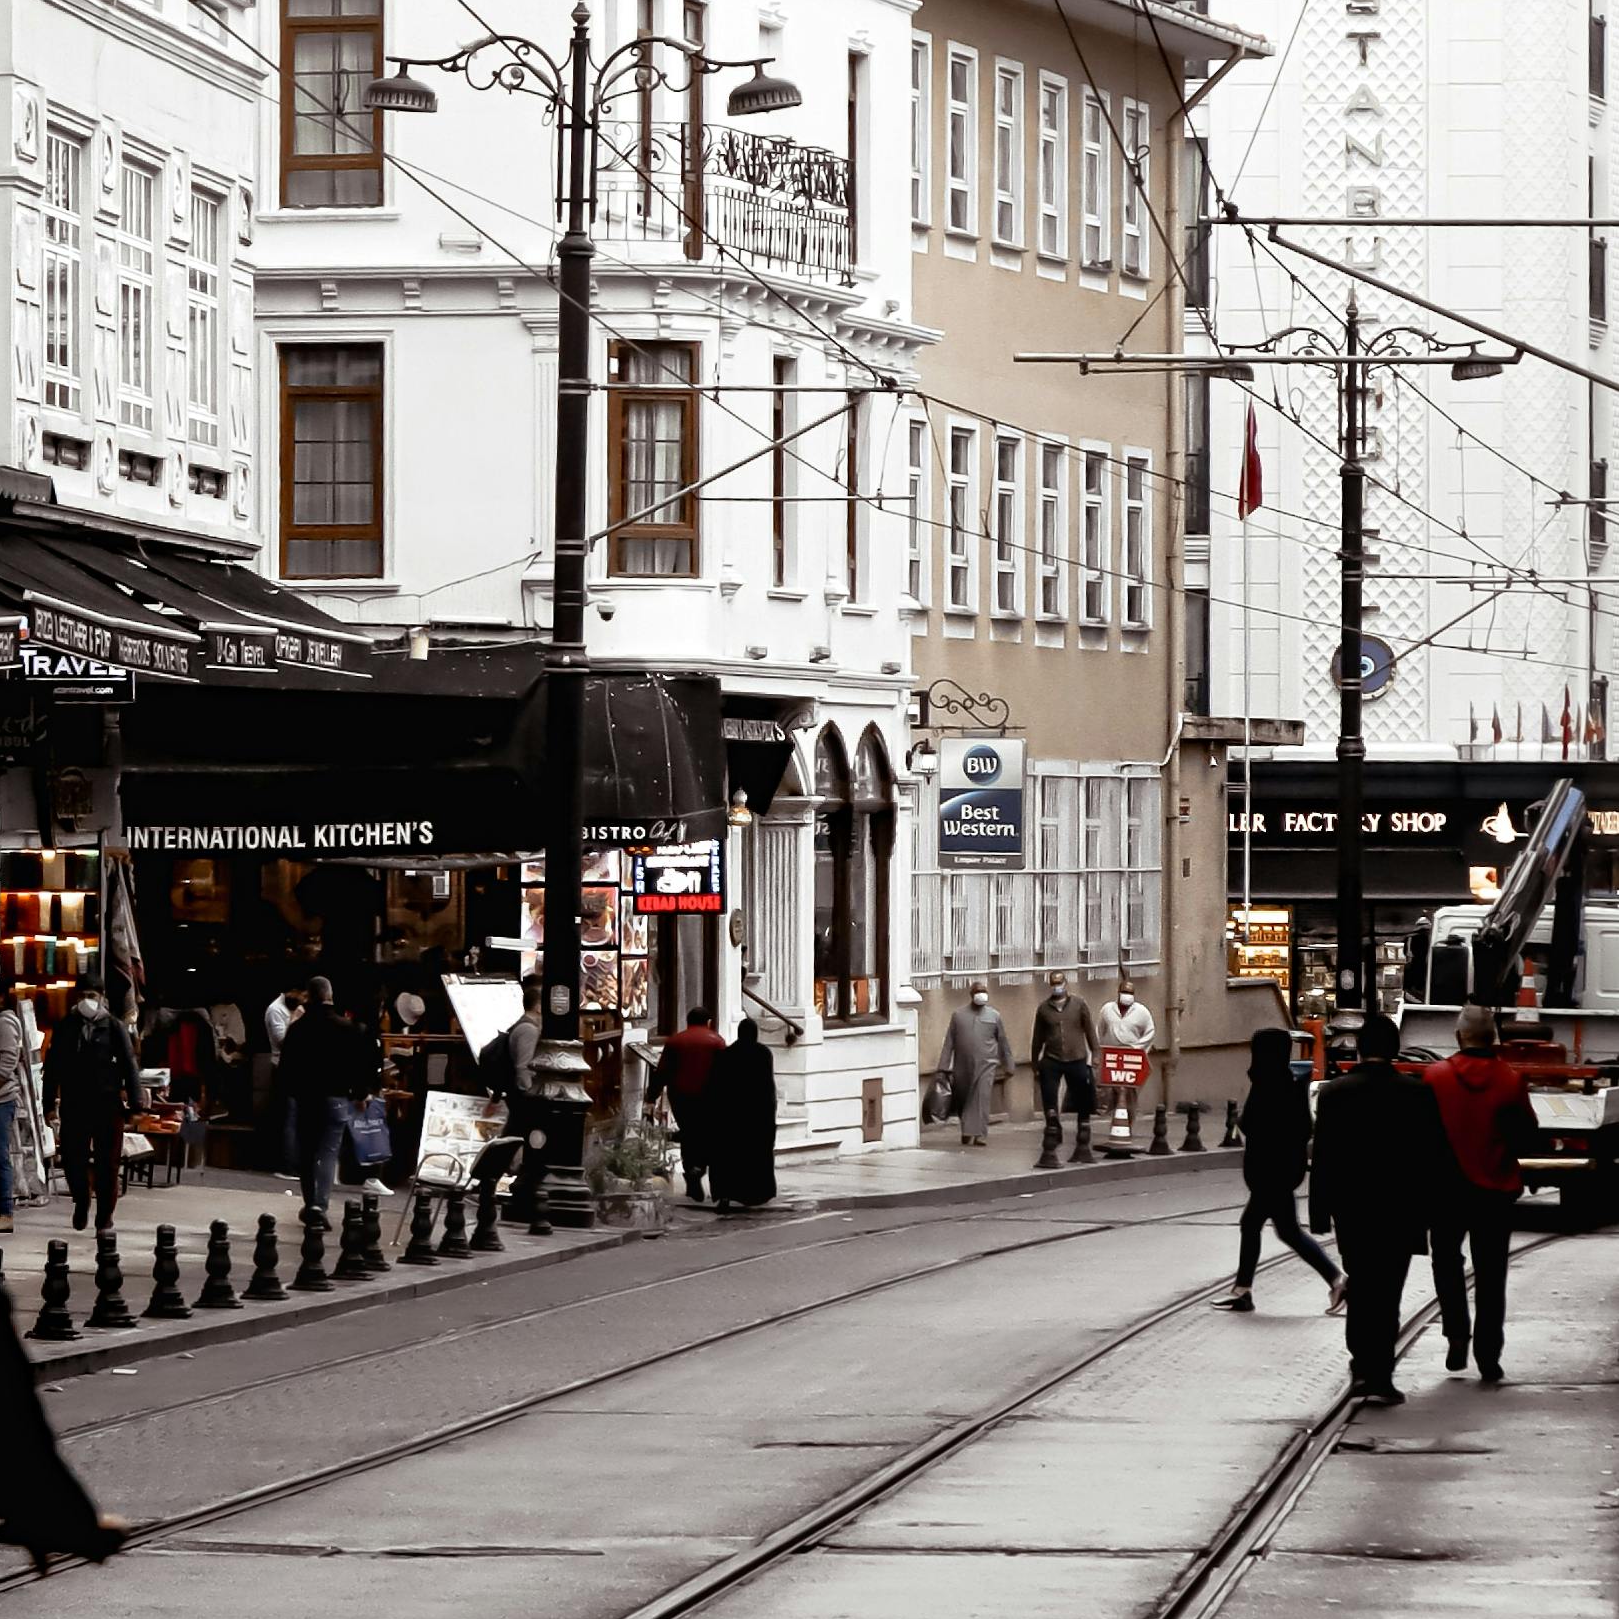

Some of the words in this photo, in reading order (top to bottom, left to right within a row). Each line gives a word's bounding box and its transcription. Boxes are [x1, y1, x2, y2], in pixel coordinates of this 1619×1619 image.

[967, 757, 998, 774] BW
[961, 804, 1000, 820] Best
[943, 820, 1016, 836] Western
[1391, 812, 1447, 832] SHOP
[127, 826, 306, 849] INTERNATIONAL
[314, 821, 433, 848] KITCHEN'S
[637, 896, 676, 911] KEBAB
[678, 895, 721, 910] HOUSE
[1110, 1070, 1137, 1083] WC
